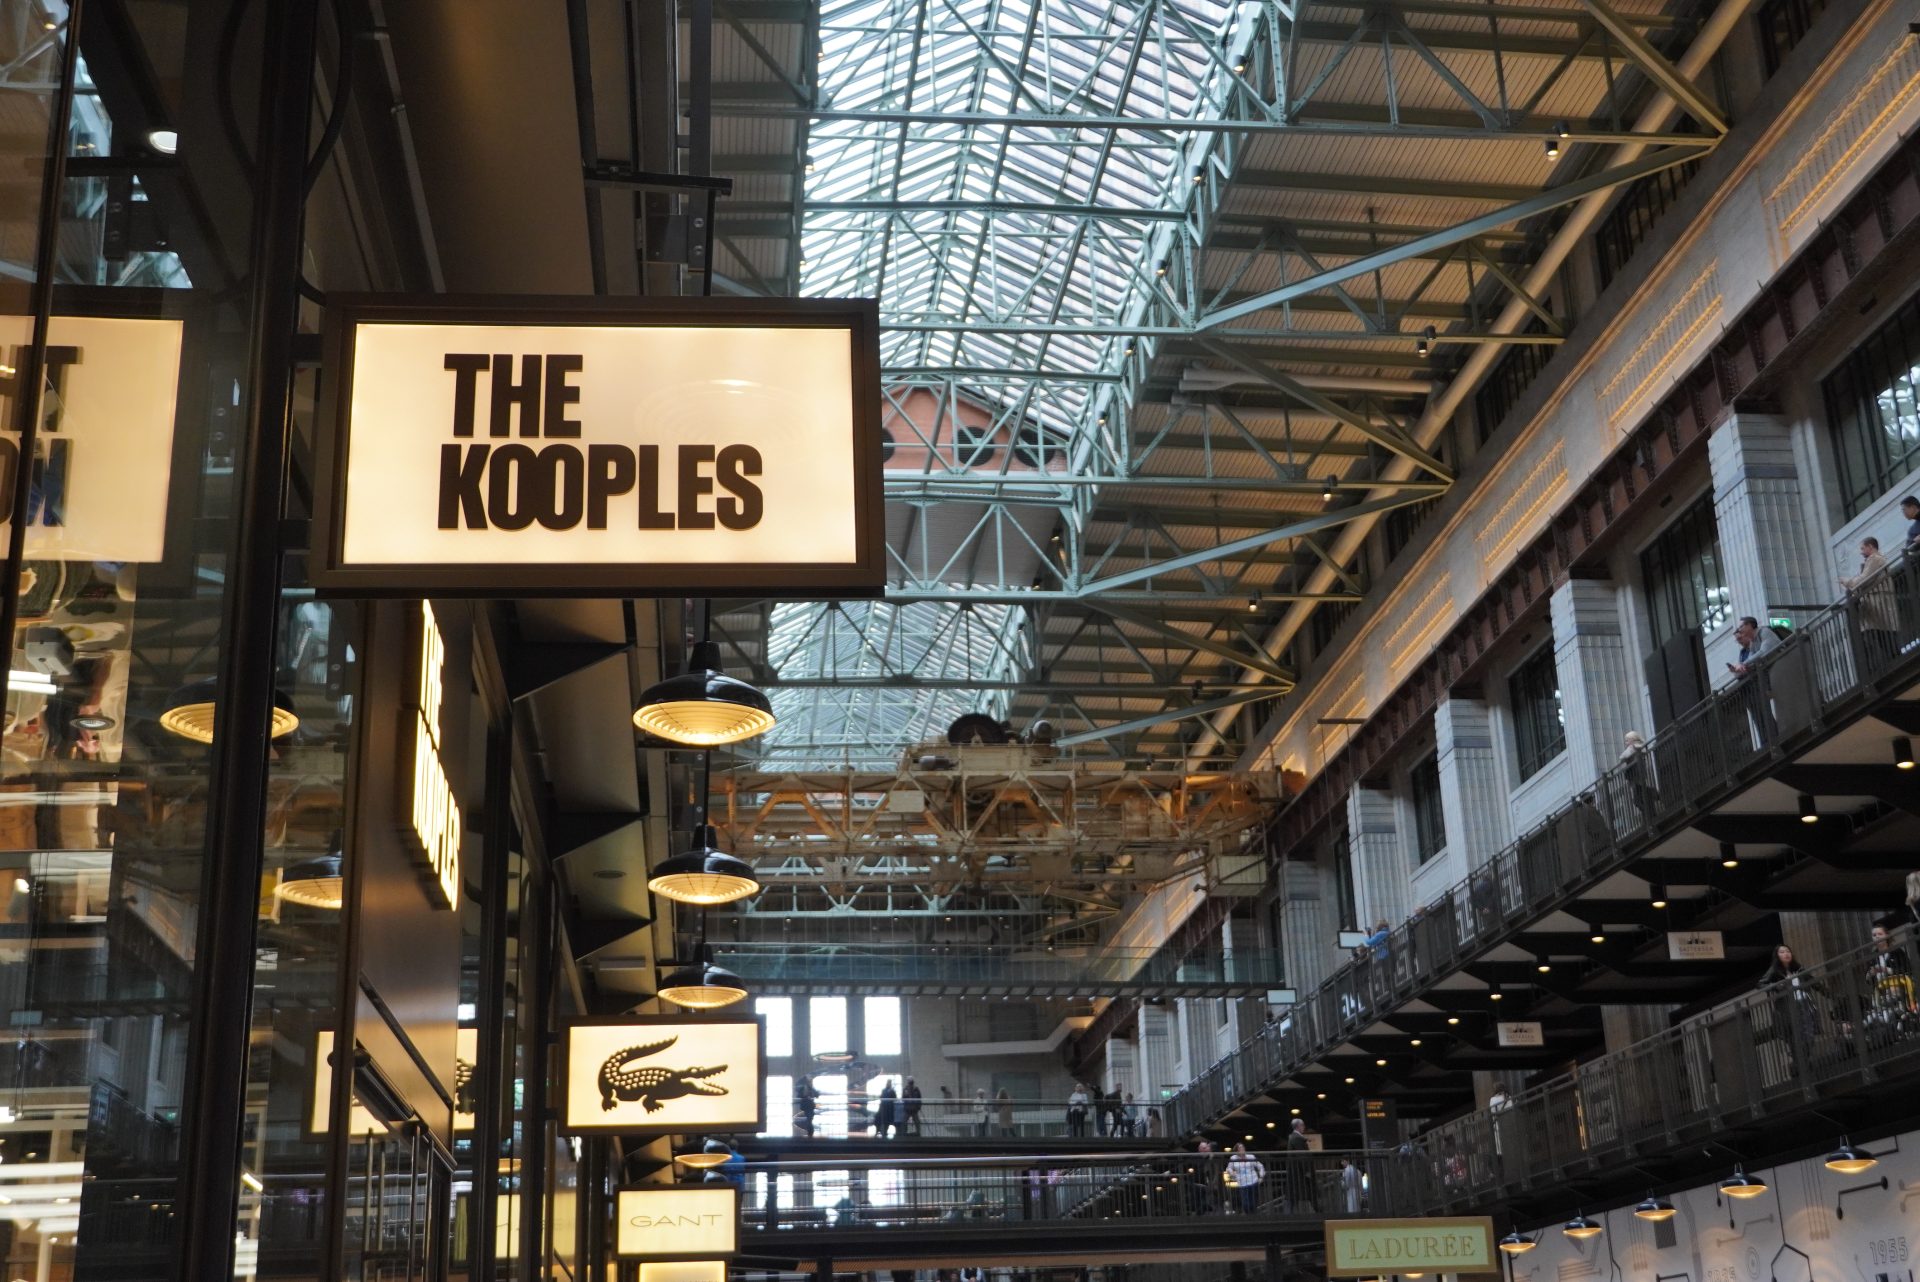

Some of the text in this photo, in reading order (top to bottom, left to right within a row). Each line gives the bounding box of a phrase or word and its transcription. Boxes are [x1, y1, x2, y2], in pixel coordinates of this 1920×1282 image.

[444, 353, 583, 438] THE
[438, 443, 763, 531] KOOPLES
[630, 1214, 723, 1227] GANT
[1350, 1234, 1475, 1260] LADURÉE
[1869, 1236, 1909, 1265] 1955
